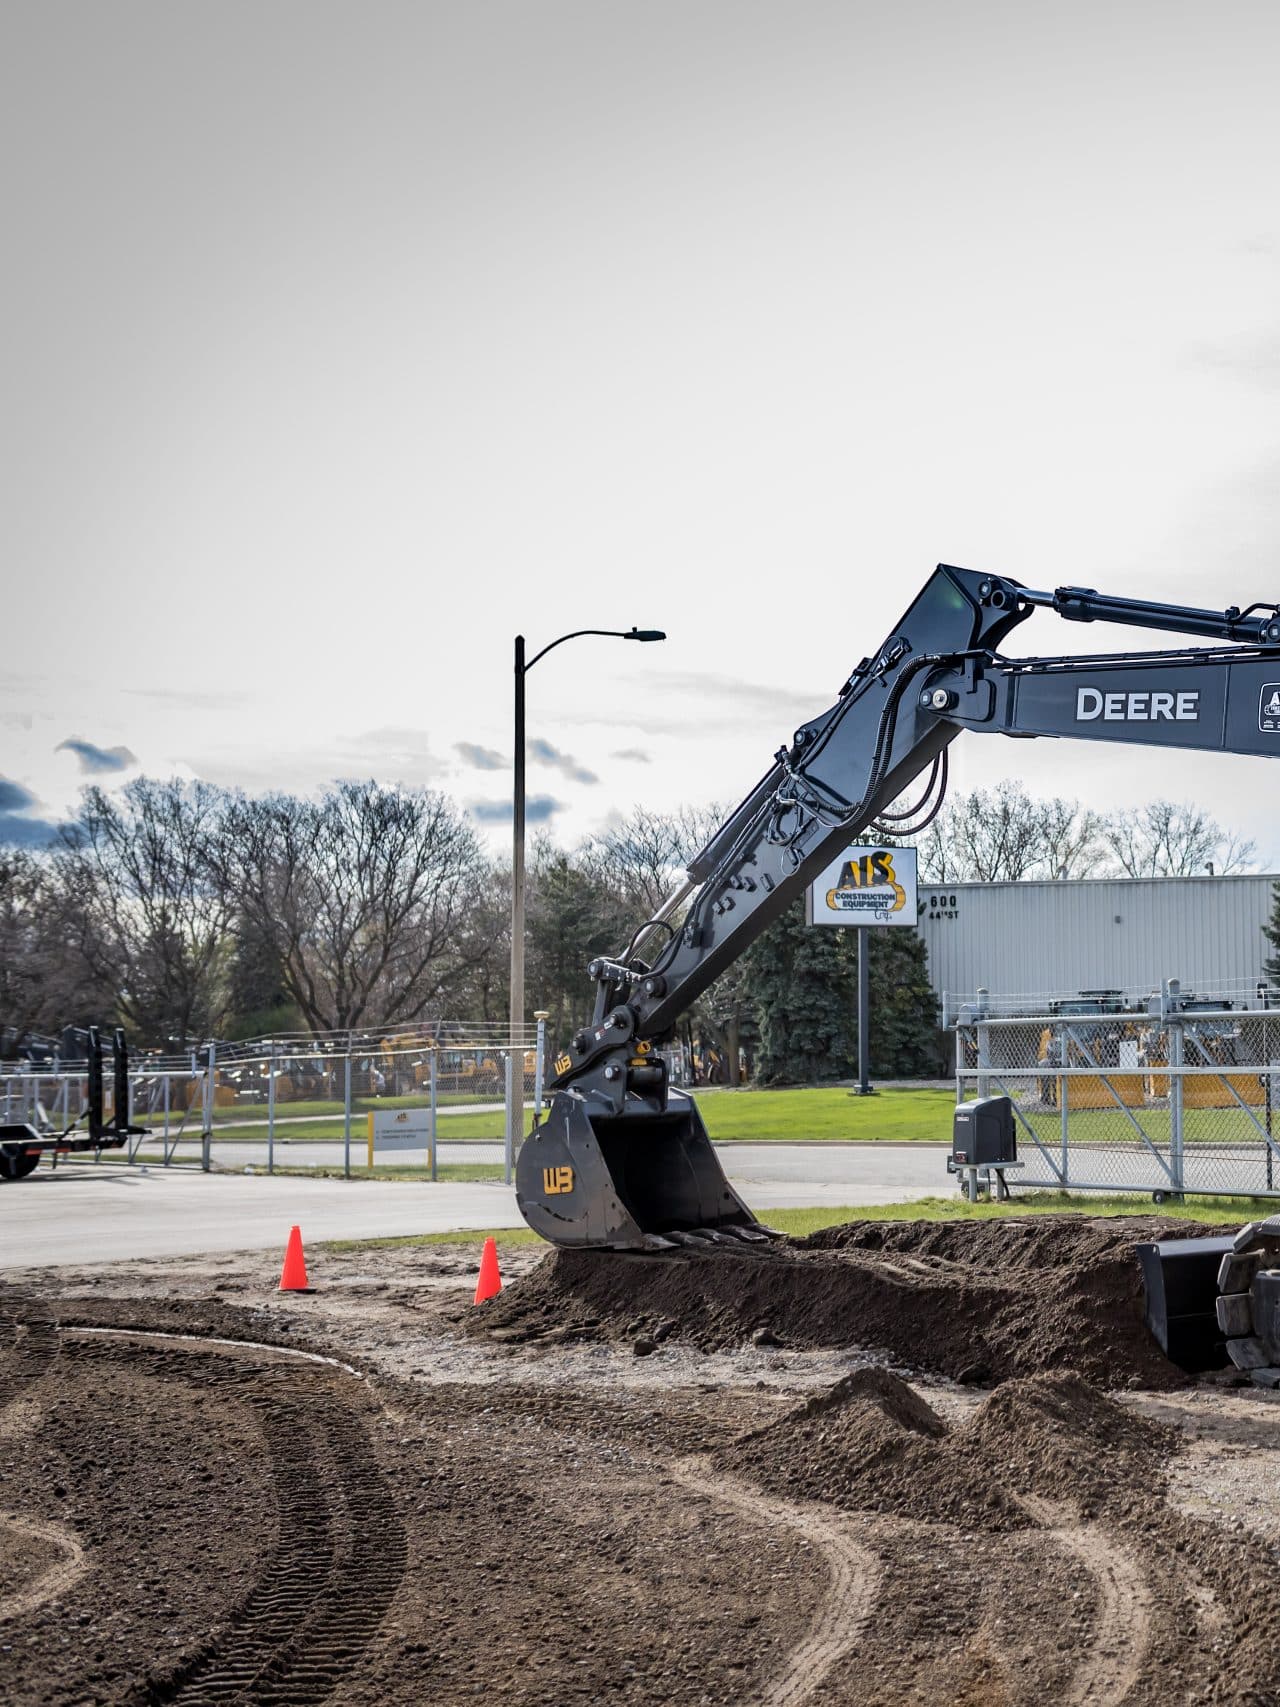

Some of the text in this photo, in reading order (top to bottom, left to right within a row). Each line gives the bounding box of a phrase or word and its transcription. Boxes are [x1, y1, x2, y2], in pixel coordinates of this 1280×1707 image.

[1077, 688, 1198, 720] DEERE
[837, 851, 895, 889] AIS
[931, 896, 956, 907] 600
